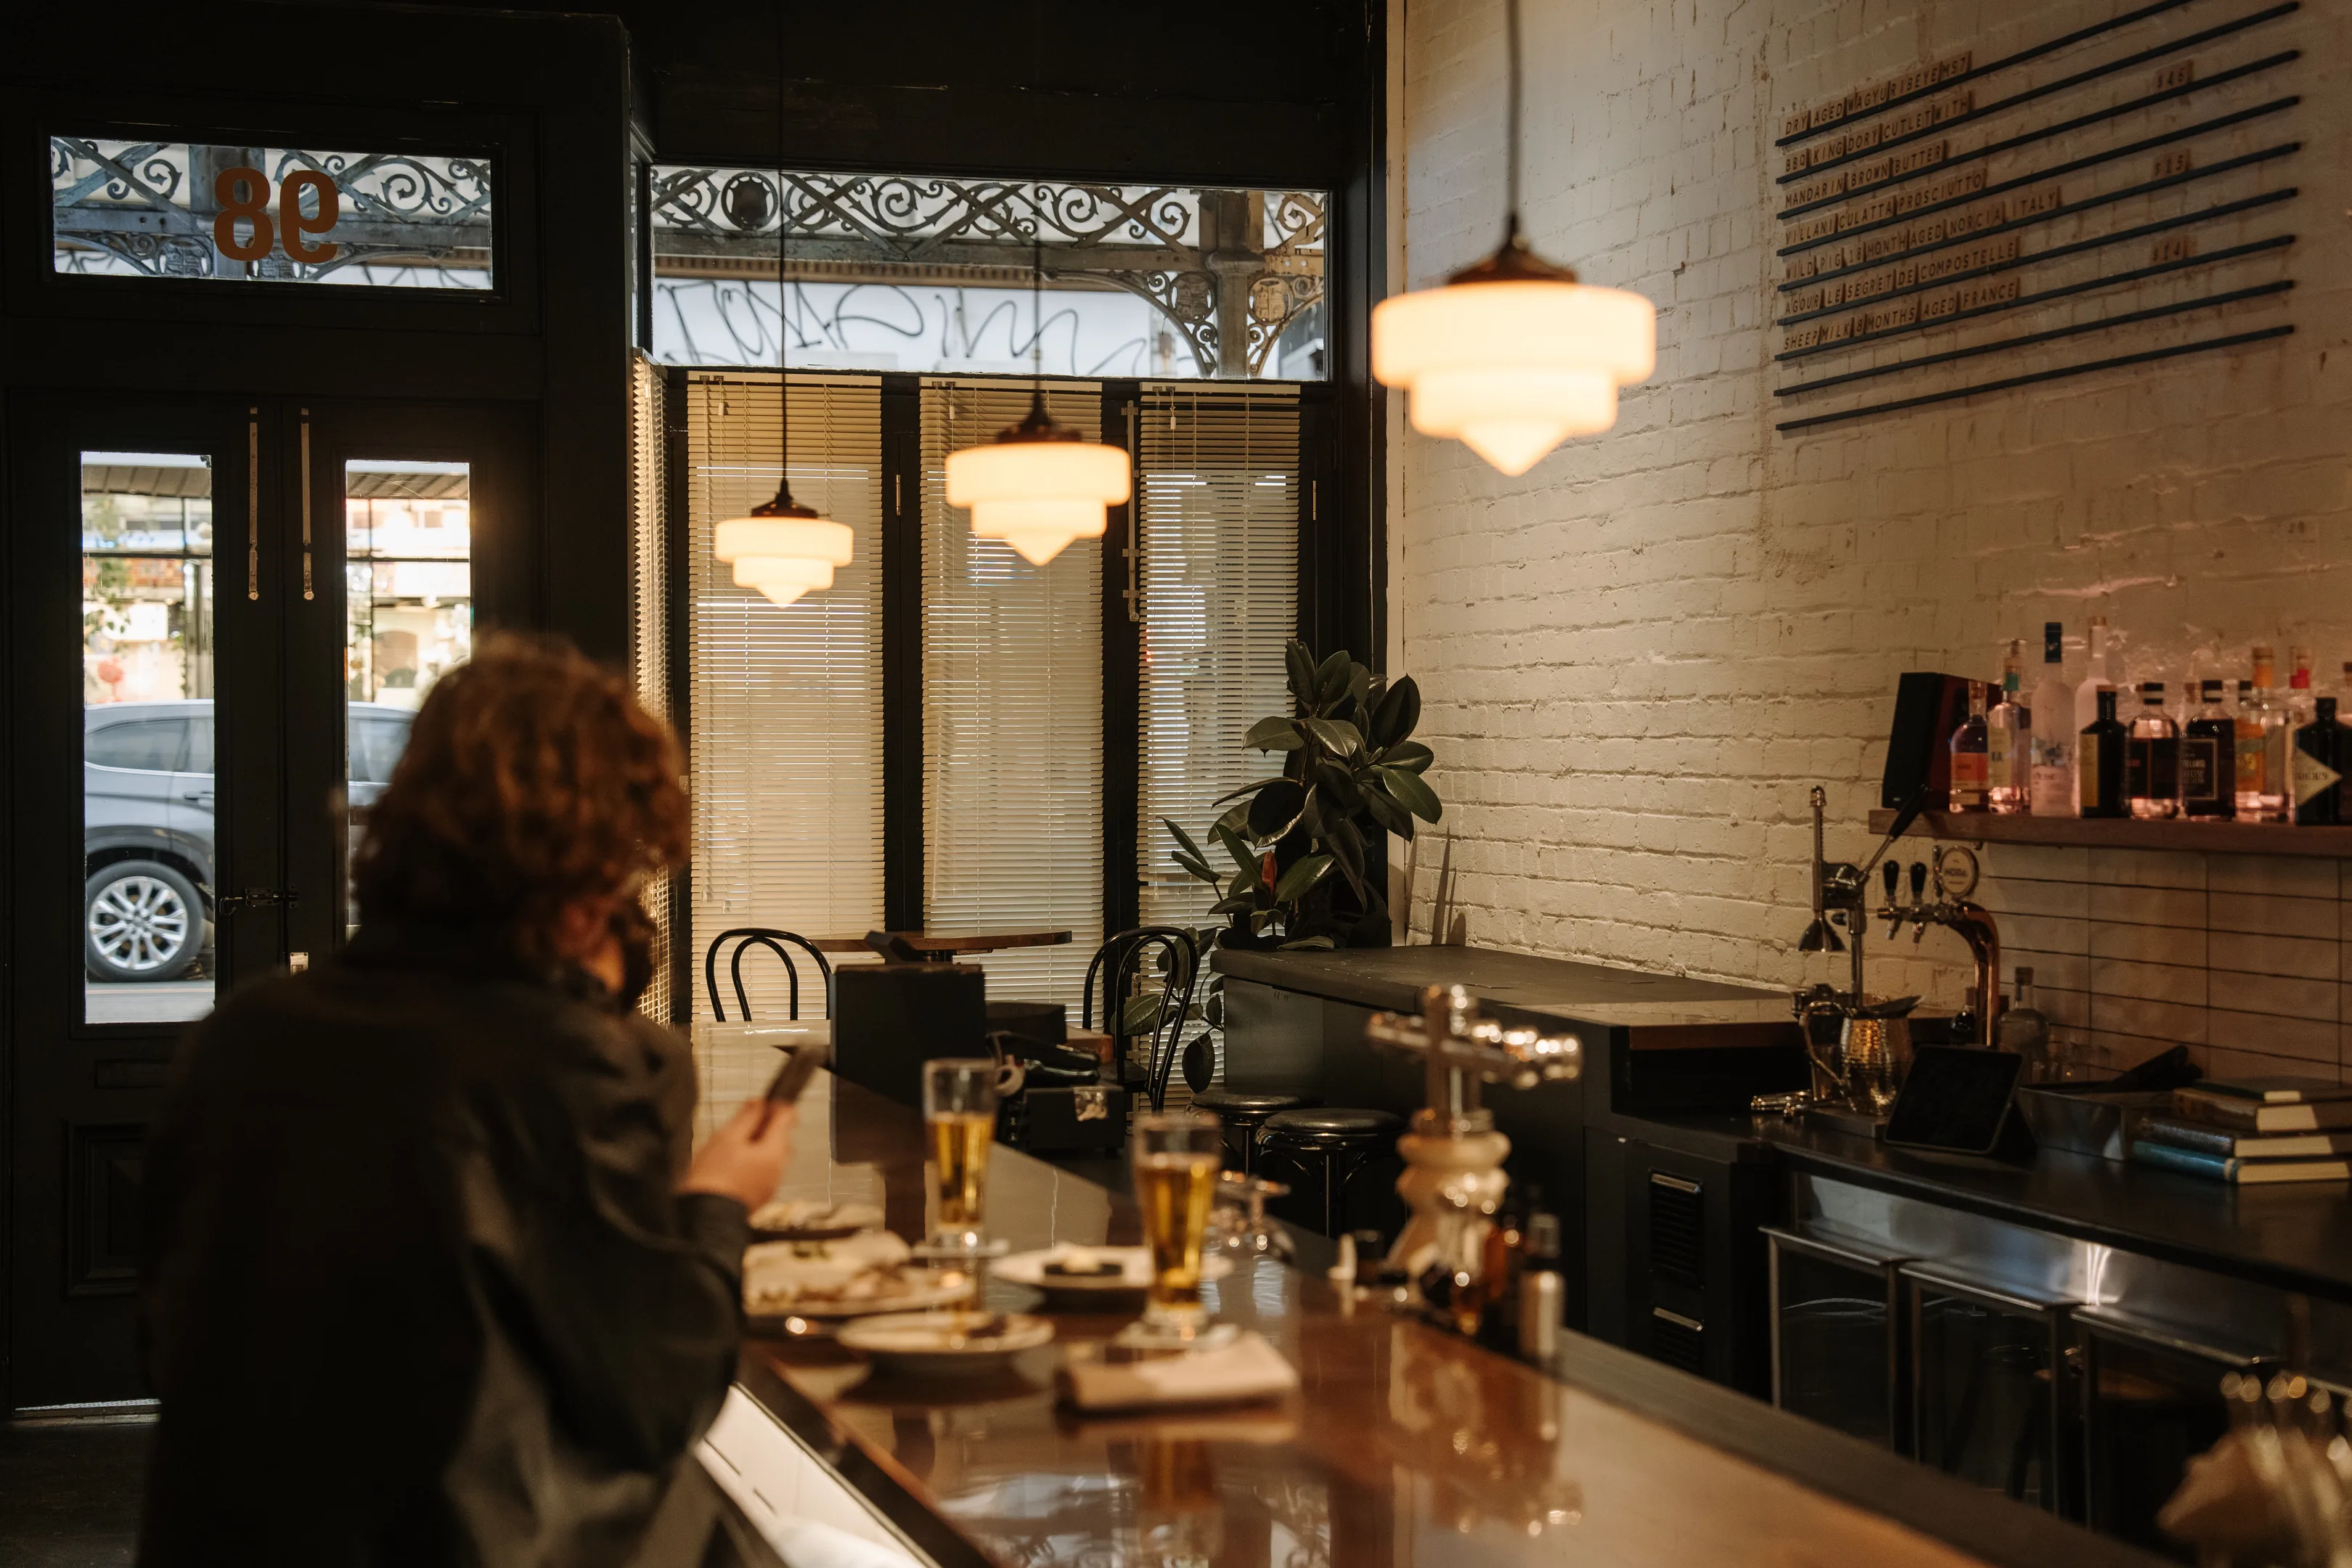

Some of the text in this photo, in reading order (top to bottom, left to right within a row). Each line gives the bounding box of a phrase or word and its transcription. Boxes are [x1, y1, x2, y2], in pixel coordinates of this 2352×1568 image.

[1785, 56, 1967, 135] DRY AGED WAGYU RIBEYE MS7
[1785, 96, 1967, 172] BBQ KING DORY CUTLET WITH
[1785, 145, 1941, 208] MANDARIN BROWN BUTTER
[1785, 173, 1982, 245] VILLANI CULATTA PROSCIUTTO
[1784, 192, 2055, 282] WILD PIG 18 MONTH AGED NORCIA ITALY
[1785, 294, 1820, 315] AGOUR
[1826, 288, 1841, 304] LE
[1898, 269, 1914, 286] DE
[1920, 242, 2014, 280] COMPOSTELLE
[1784, 282, 2015, 350] SHEEP MILK 8 MONTHS AGED FRANCE
